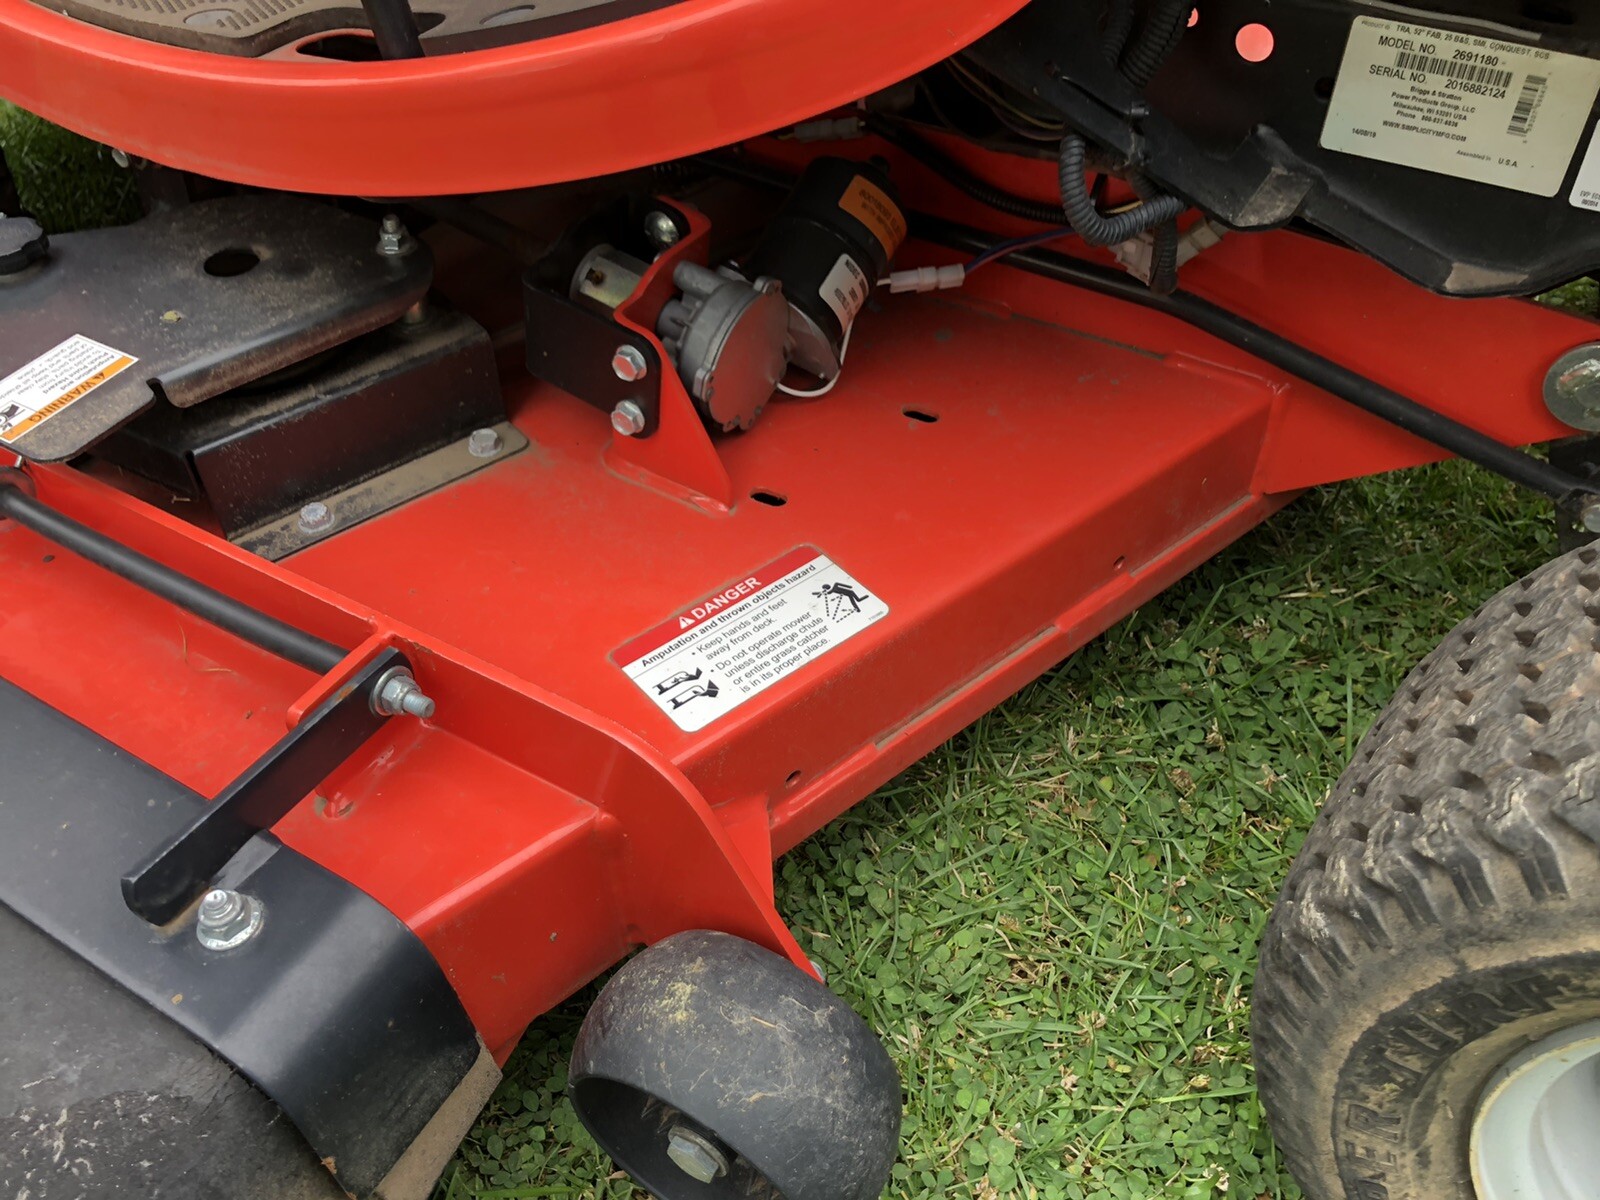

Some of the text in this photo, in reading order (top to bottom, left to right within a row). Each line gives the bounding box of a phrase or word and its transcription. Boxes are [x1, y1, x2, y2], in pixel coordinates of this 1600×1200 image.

[1378, 35, 1416, 52] MODEL
[1452, 49, 1500, 67] 2691180
[1369, 64, 1406, 80] SERIAL
[1444, 78, 1506, 100] 2016882124
[1392, 91, 1410, 102] Power
[1411, 94, 1438, 106] Products
[1462, 104, 1476, 114] LLC
[1410, 86, 1430, 97] Briggs
[1438, 90, 1462, 102] Stratton
[1393, 100, 1424, 114] Milwaukee,
[1454, 112, 1467, 121] USA
[1396, 110, 1416, 120] Phone
[1456, 149, 1484, 160] Assembled
[28, 380, 98, 422] WARNING
[642, 564, 816, 668] Amputation and thrown objects hazard
[691, 576, 762, 620] DANGER
[697, 598, 788, 654] Keep hands and feet
[706, 617, 778, 662] away from deck.
[715, 610, 812, 672] Do not operate mower
[724, 615, 824, 679] unless discharge chute
[732, 624, 829, 686] or entire grass catcher
[740, 638, 832, 694] is in its proper place.
